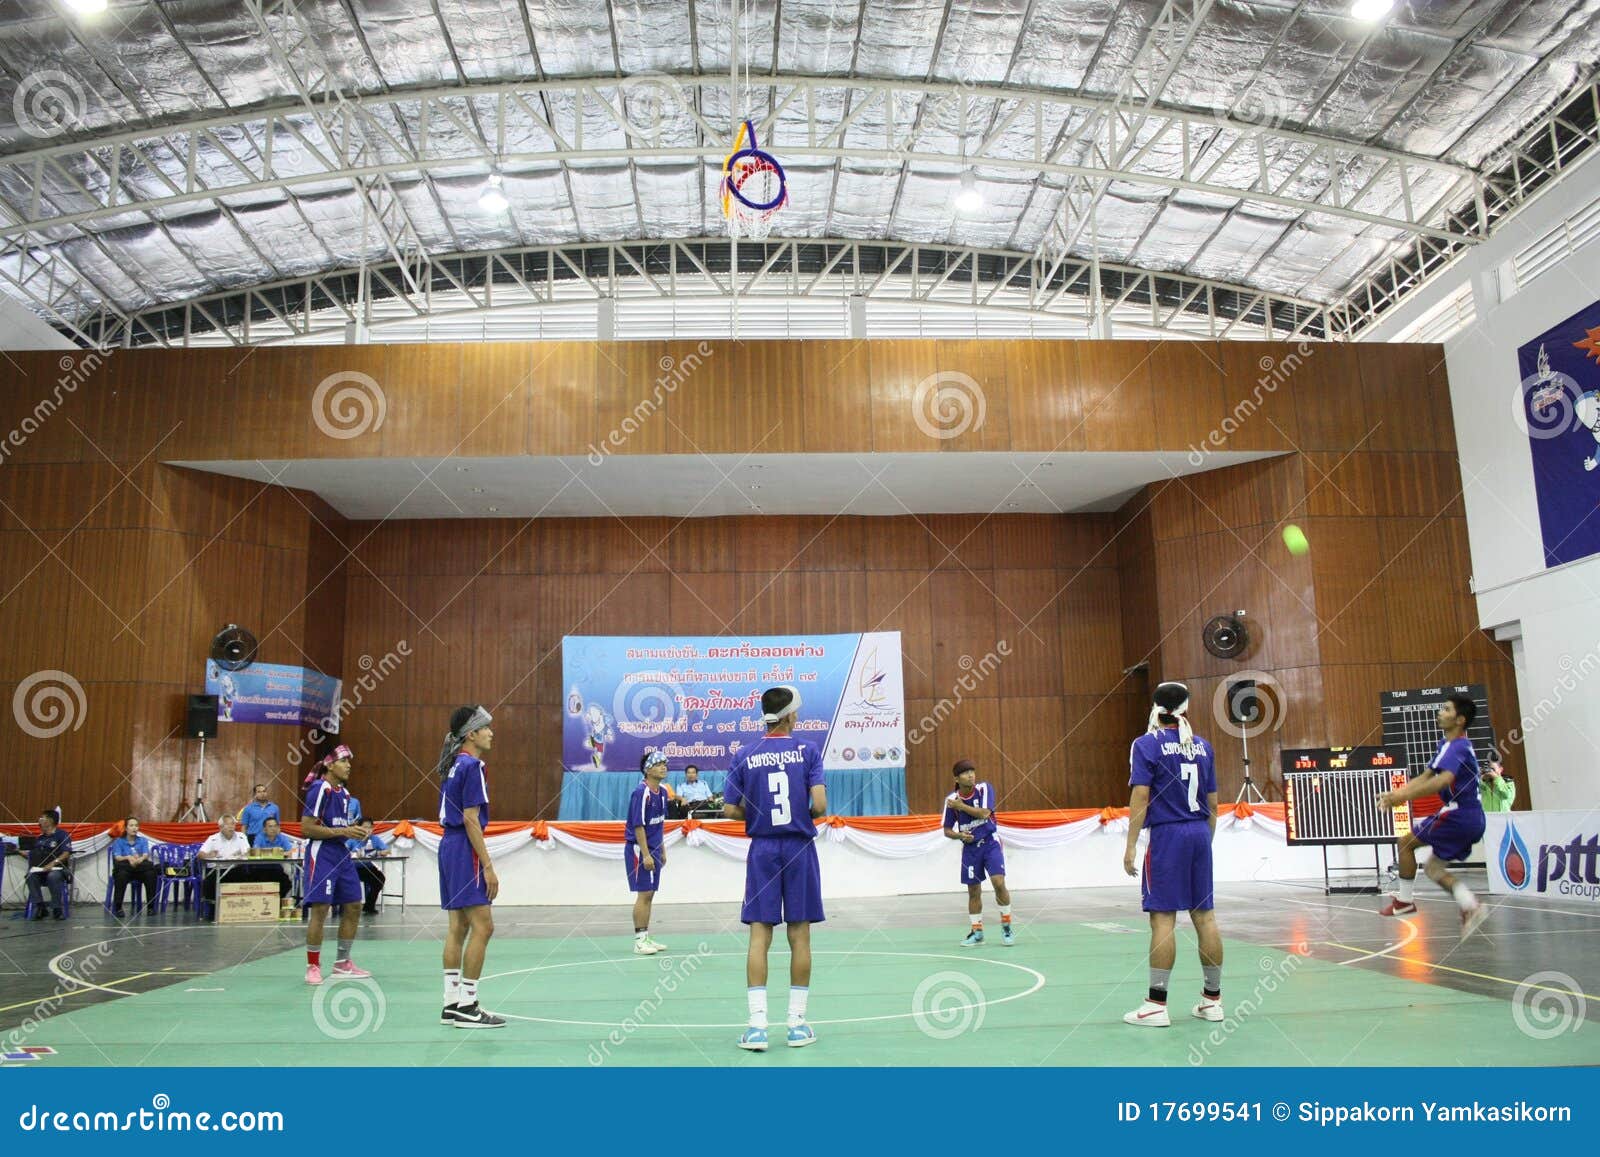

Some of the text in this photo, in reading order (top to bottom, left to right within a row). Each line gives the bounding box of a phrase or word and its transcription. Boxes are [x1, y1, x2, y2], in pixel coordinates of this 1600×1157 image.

[1422, 688, 1442, 696] SCORE
[746, 744, 806, 771] เพชรบูรณ์
[768, 771, 792, 826] 3
[1180, 763, 1200, 812] 7
[1537, 833, 1600, 893] ptt
[1560, 880, 1600, 901] Group
